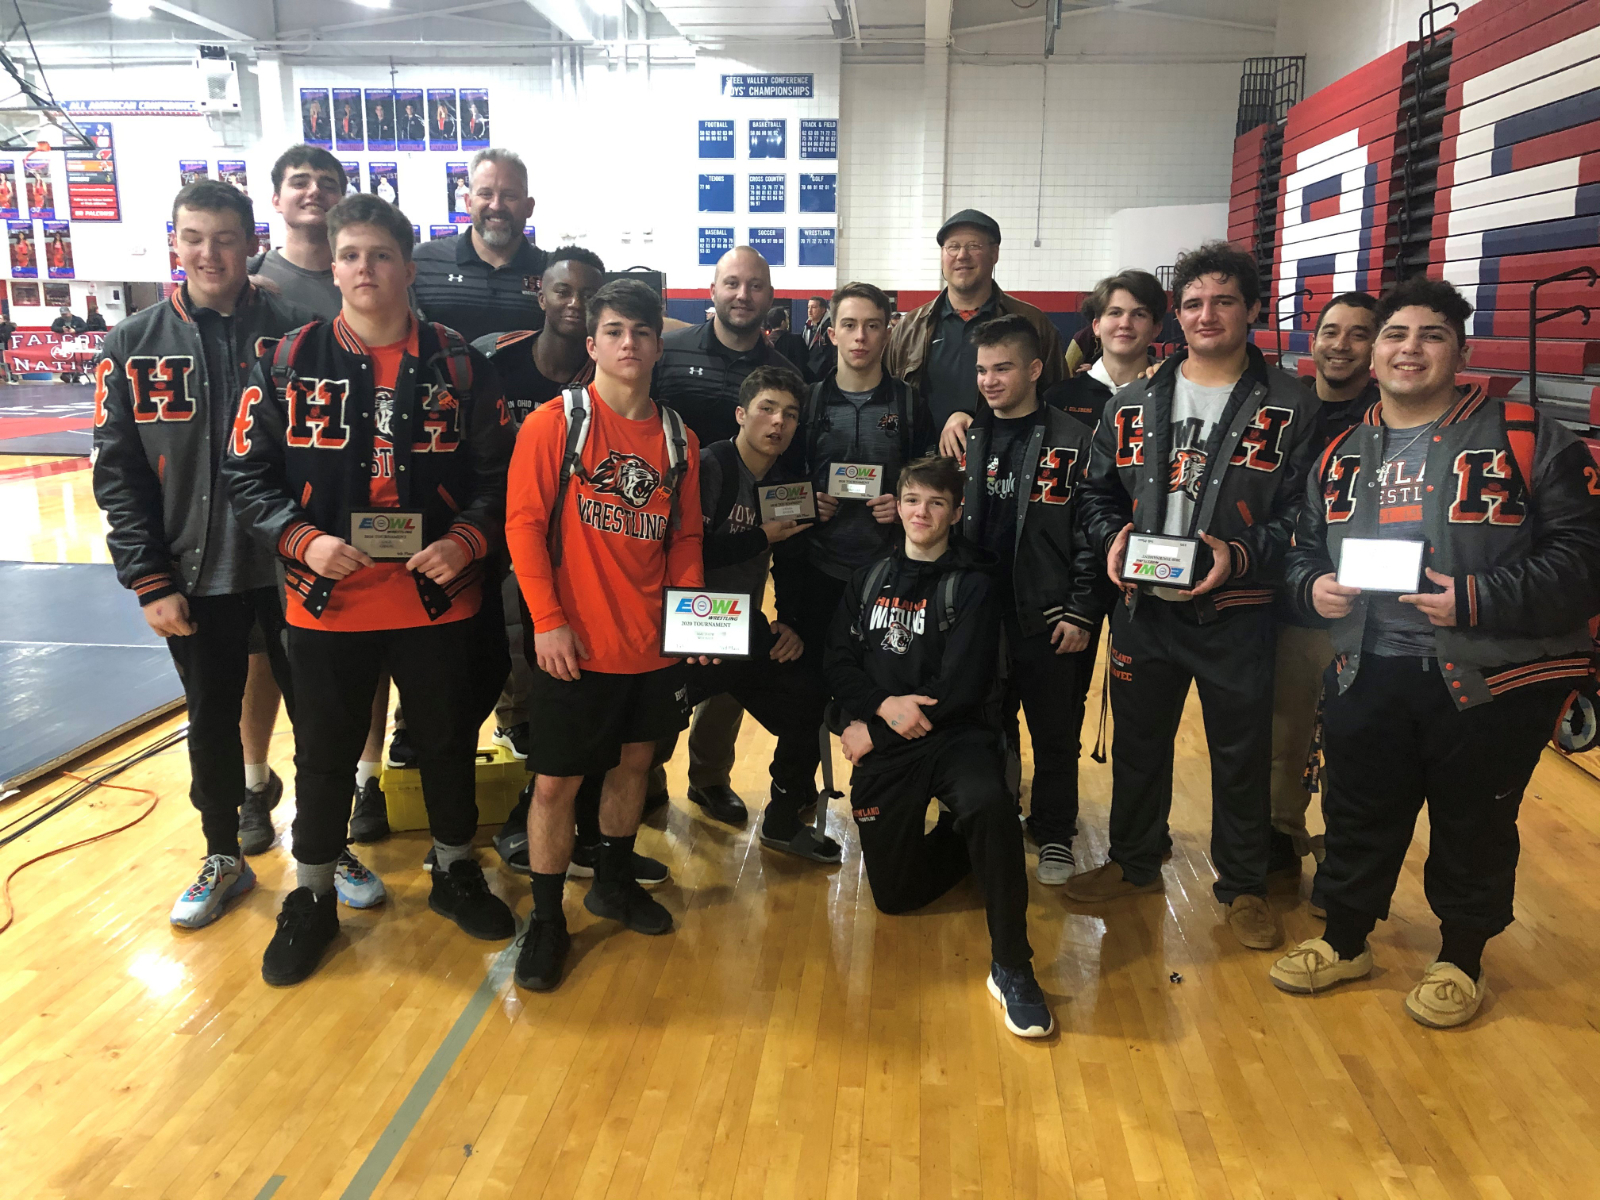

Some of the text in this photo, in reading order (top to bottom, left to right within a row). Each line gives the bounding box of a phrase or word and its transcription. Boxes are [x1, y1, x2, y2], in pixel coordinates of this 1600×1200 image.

[748, 86, 810, 96] CHAMPIONSHIPS
[126, 355, 197, 423] H
[286, 377, 350, 450] H
[517, 400, 532, 408] OHIO
[1230, 405, 1295, 472] H
[576, 493, 668, 542] WRESTLING
[1449, 449, 1527, 526] H
